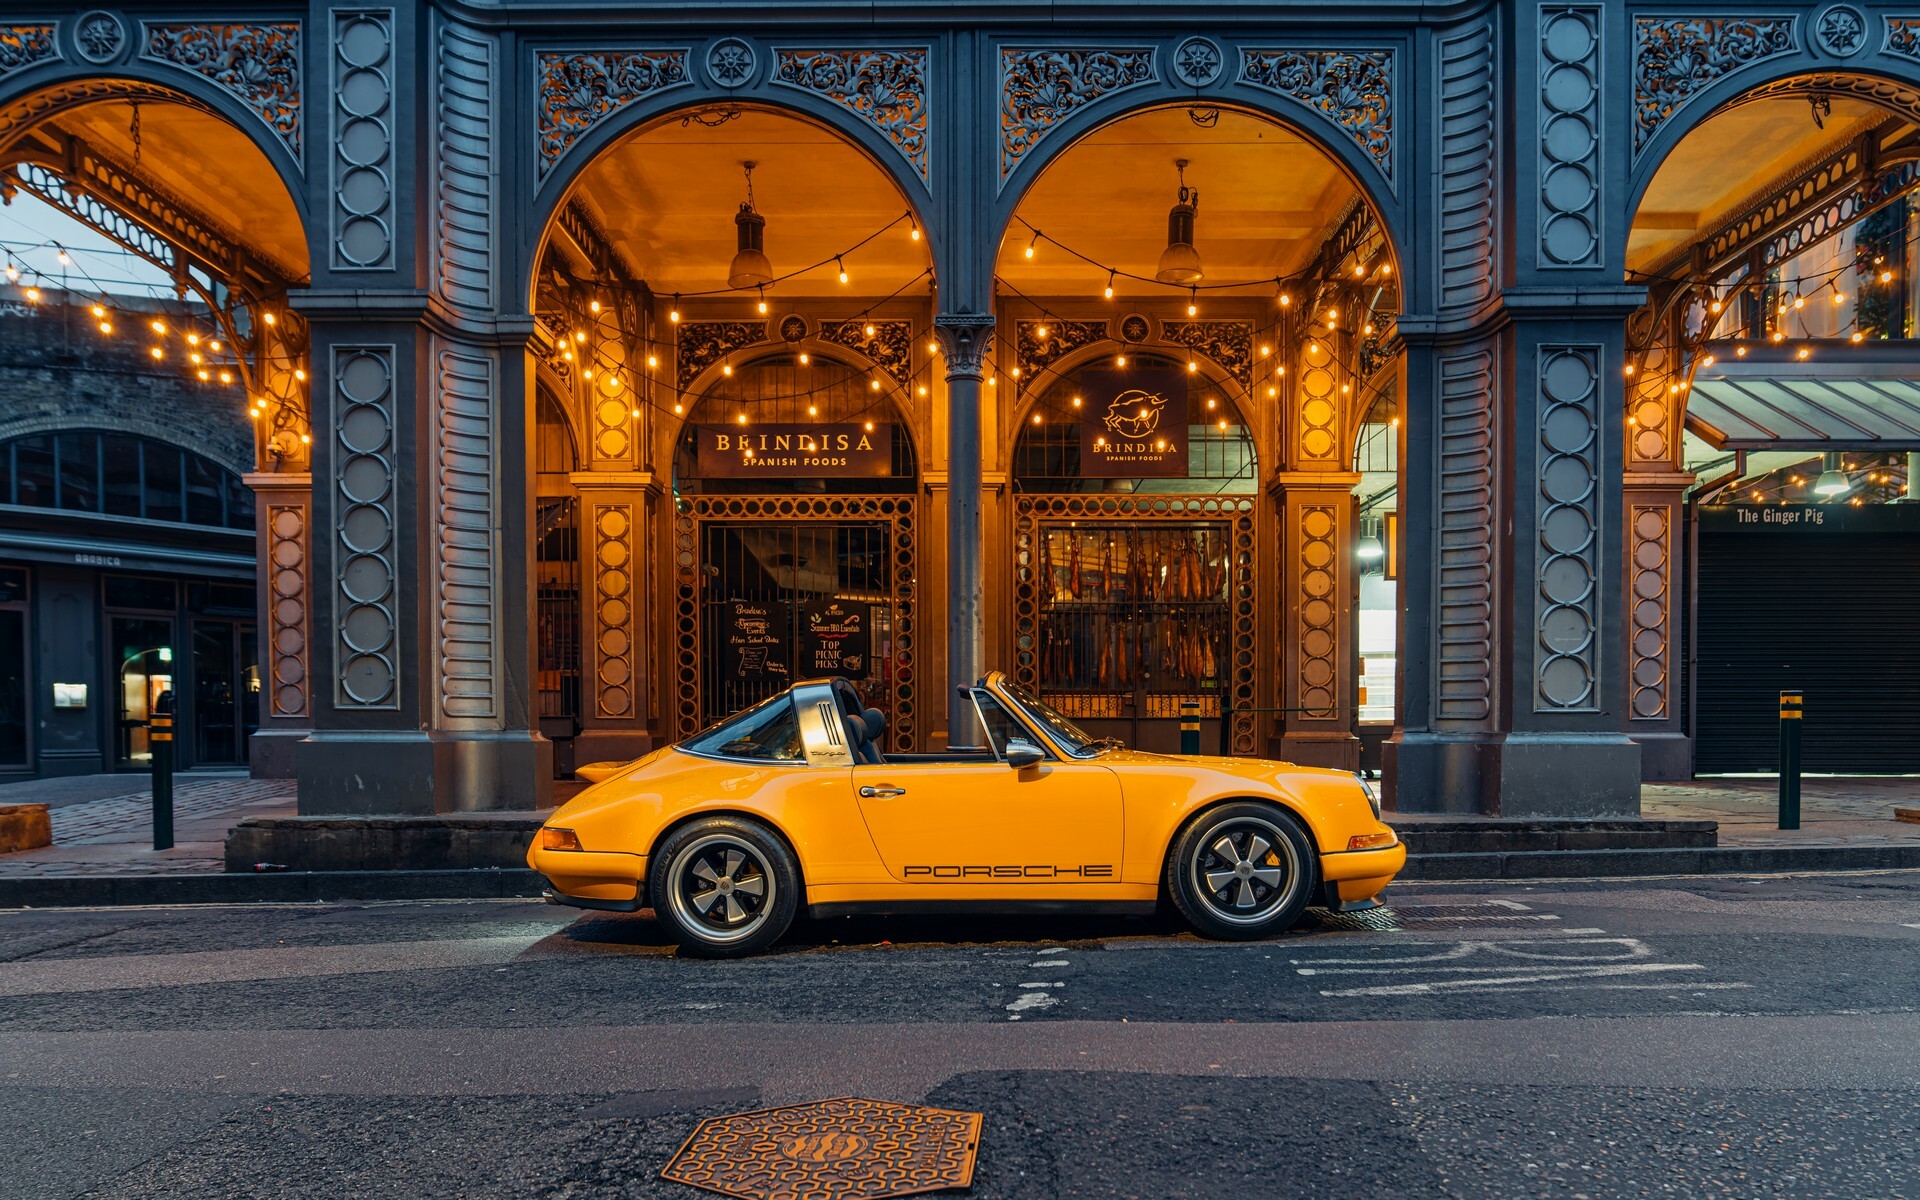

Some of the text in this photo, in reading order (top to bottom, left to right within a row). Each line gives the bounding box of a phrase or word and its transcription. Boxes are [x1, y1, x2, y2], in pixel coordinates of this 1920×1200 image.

[715, 434, 874, 451] BRINDISA
[742, 457, 847, 466] SPANISH FOODS
[1737, 508, 1824, 525] The Ginger Pig
[75, 553, 121, 566] ARABICA
[810, 623, 830, 632] Summer
[820, 640, 840, 650] TOP
[815, 650, 842, 660] PICNIC
[815, 660, 839, 669] PICKS
[904, 865, 1113, 878] PORSCHE
